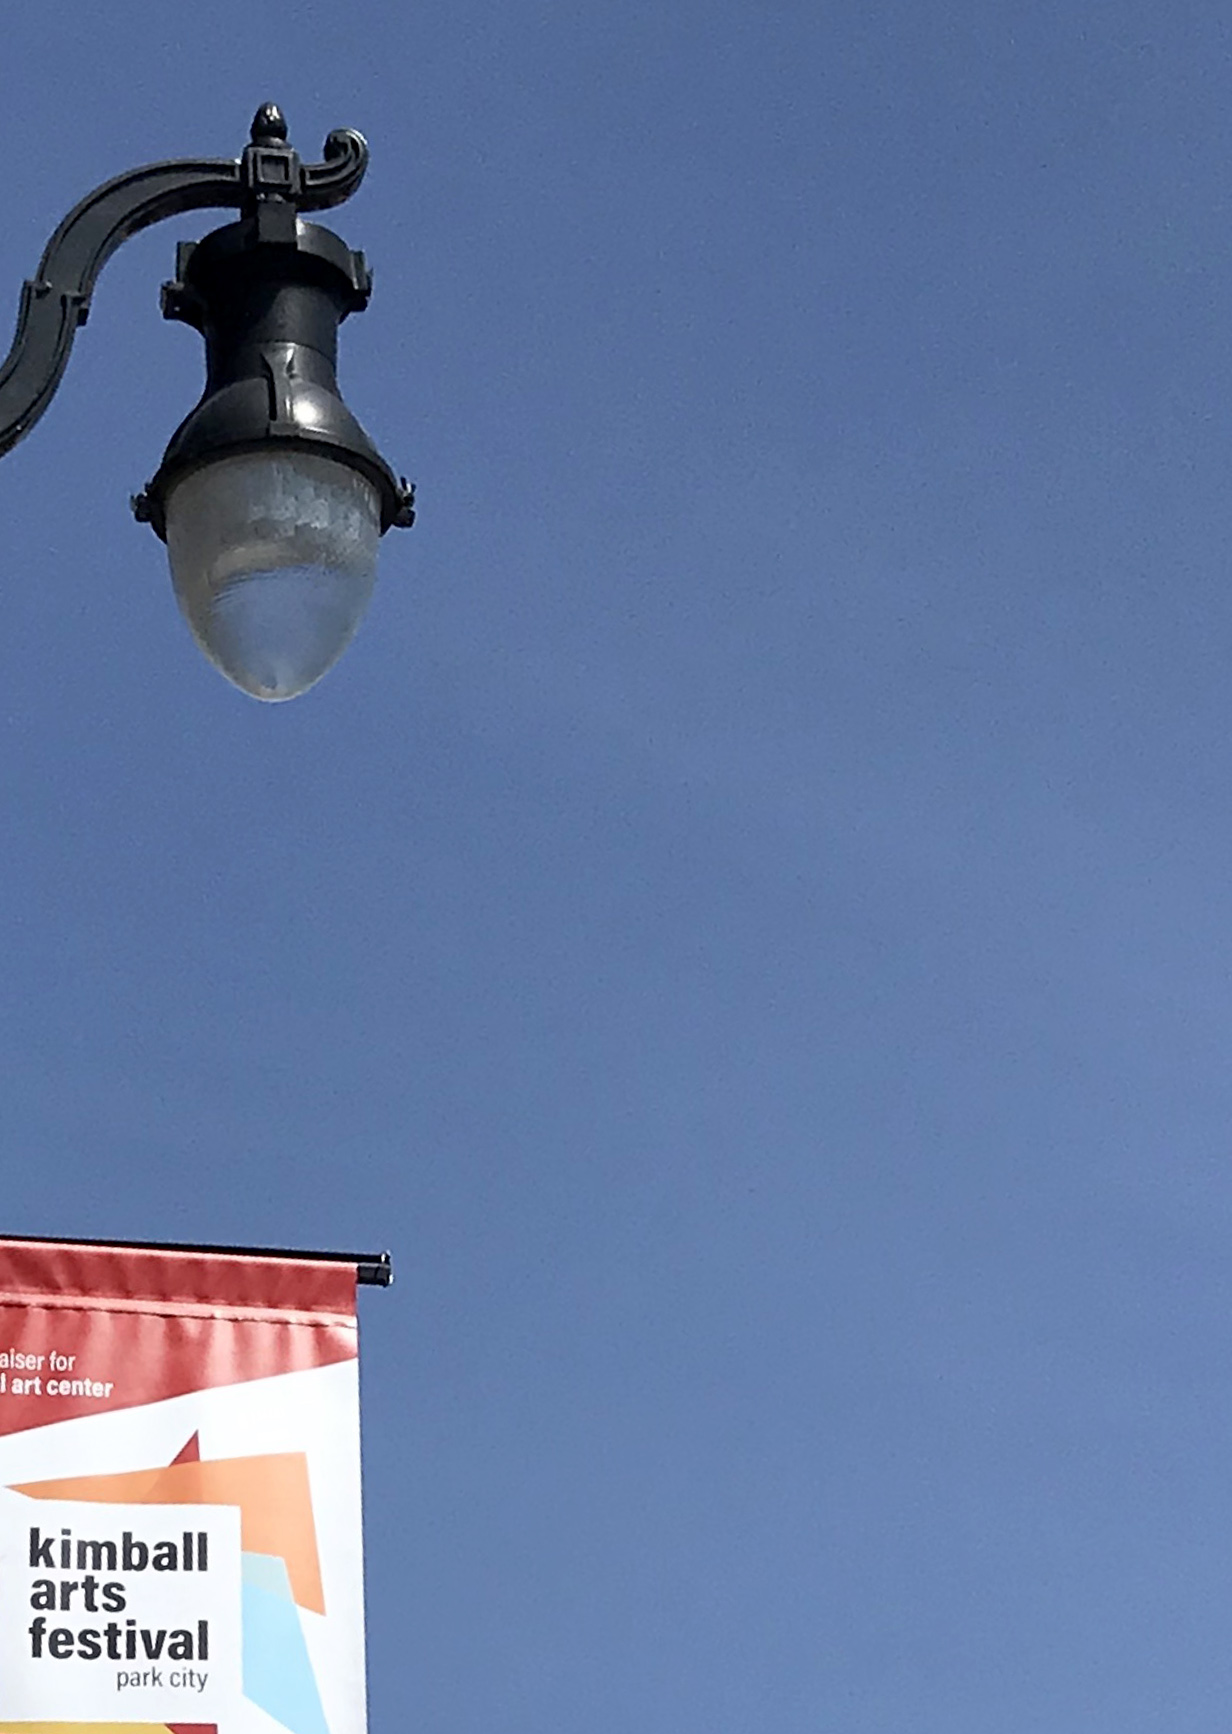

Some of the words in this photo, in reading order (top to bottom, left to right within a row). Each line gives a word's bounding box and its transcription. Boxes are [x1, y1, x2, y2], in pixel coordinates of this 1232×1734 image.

[50, 1350, 76, 1371] for
[11, 1376, 42, 1396] art
[46, 1378, 114, 1398] center
[28, 1527, 209, 1572] kimball
[29, 1574, 127, 1613] arts
[28, 1617, 210, 1661] festival
[116, 1667, 164, 1691] park
[169, 1668, 209, 1693] city
